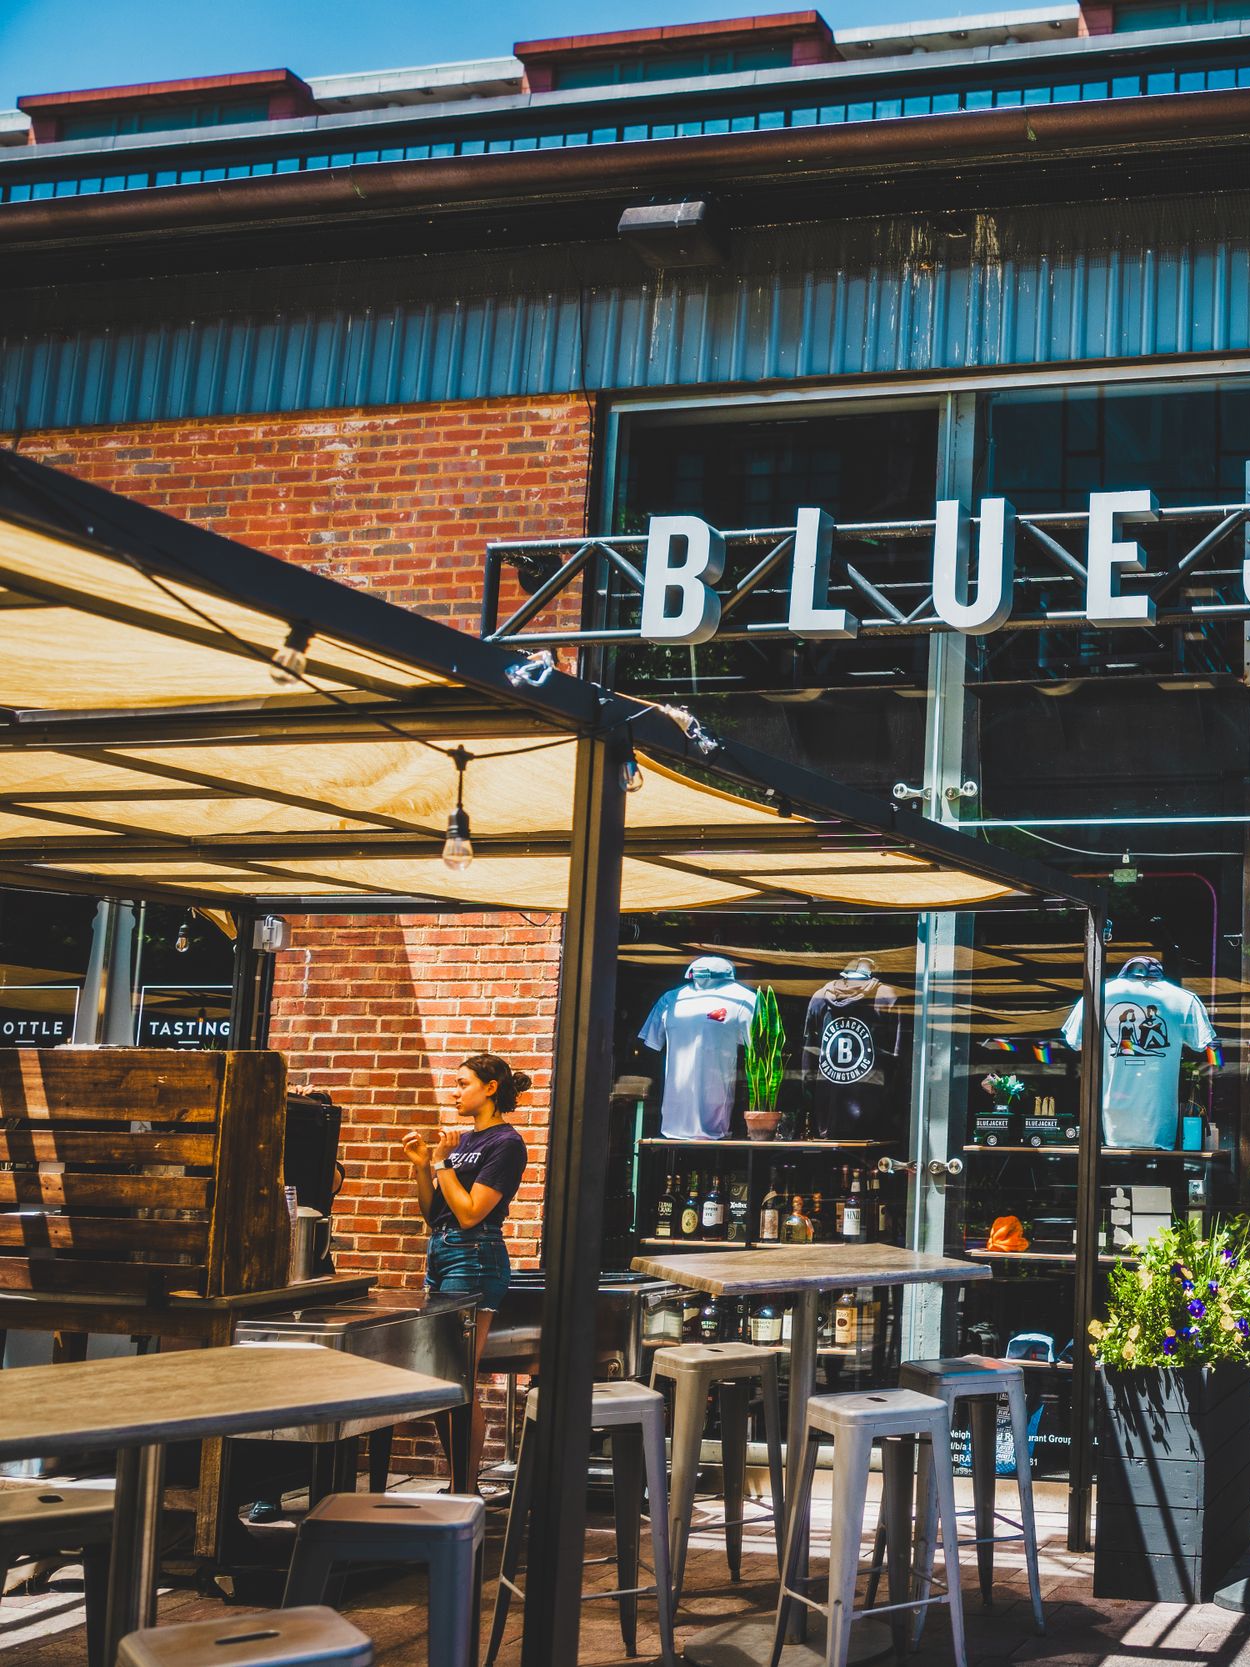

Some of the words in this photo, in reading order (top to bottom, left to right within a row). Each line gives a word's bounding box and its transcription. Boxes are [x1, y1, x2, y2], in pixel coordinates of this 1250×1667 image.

[3, 1021, 63, 1036] OTTLE
[150, 1021, 231, 1036] TASTING
[837, 1037, 853, 1064] B
